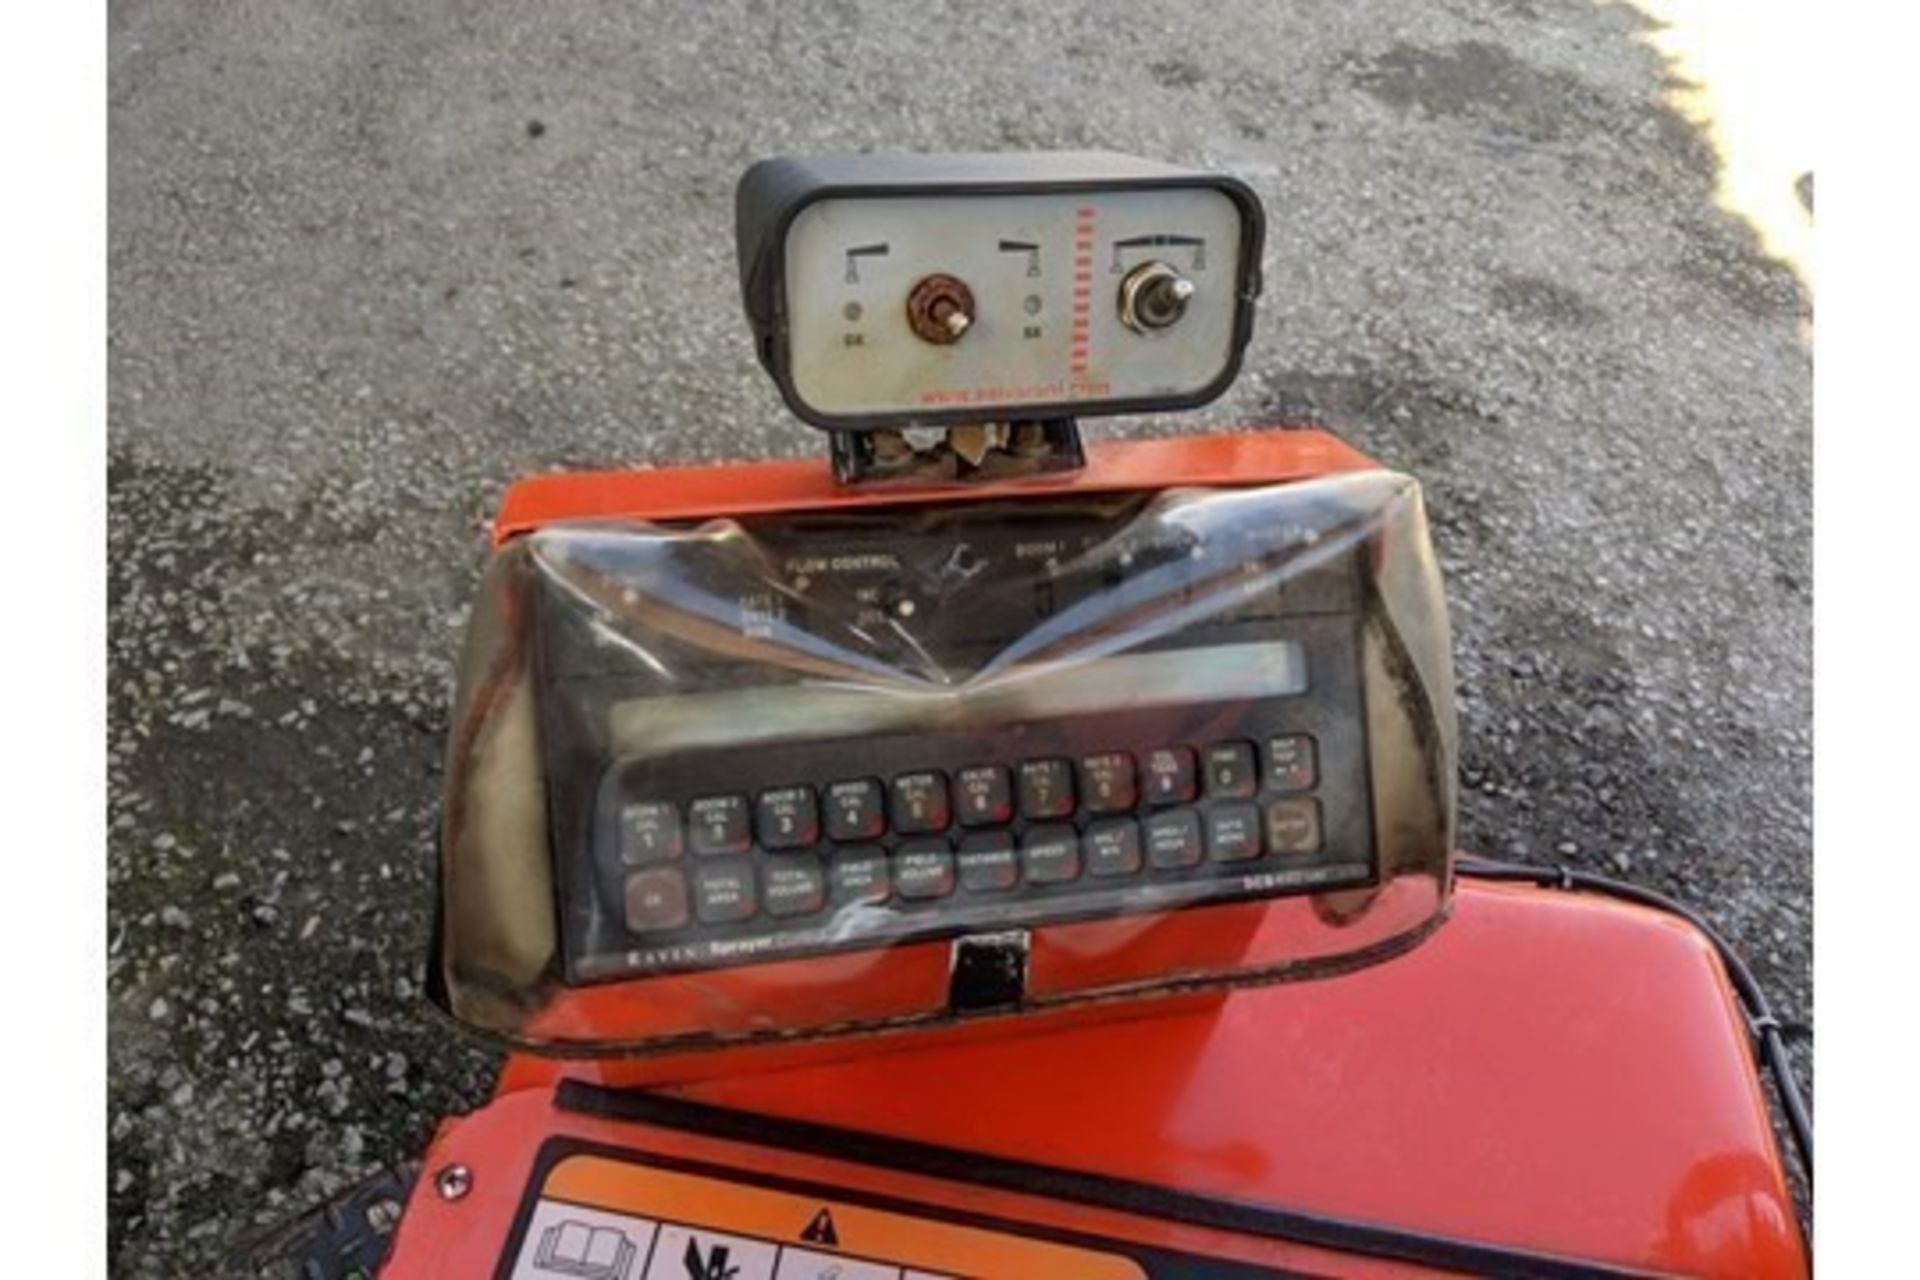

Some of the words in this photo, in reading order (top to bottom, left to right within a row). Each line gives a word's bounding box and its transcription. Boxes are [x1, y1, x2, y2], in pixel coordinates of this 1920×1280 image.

[785, 558, 827, 573] FLOW
[831, 555, 899, 571] CONTROL
[1219, 768, 1232, 785] 0
[780, 816, 793, 834] 3
[846, 809, 859, 826] 4
[1028, 843, 1067, 859] SPEED
[900, 866, 944, 880] VOLUME
[766, 881, 815, 897] VOLUME
[706, 892, 739, 904] AREA
[627, 948, 697, 967] RAVEN
[709, 937, 773, 956] Sprayer
